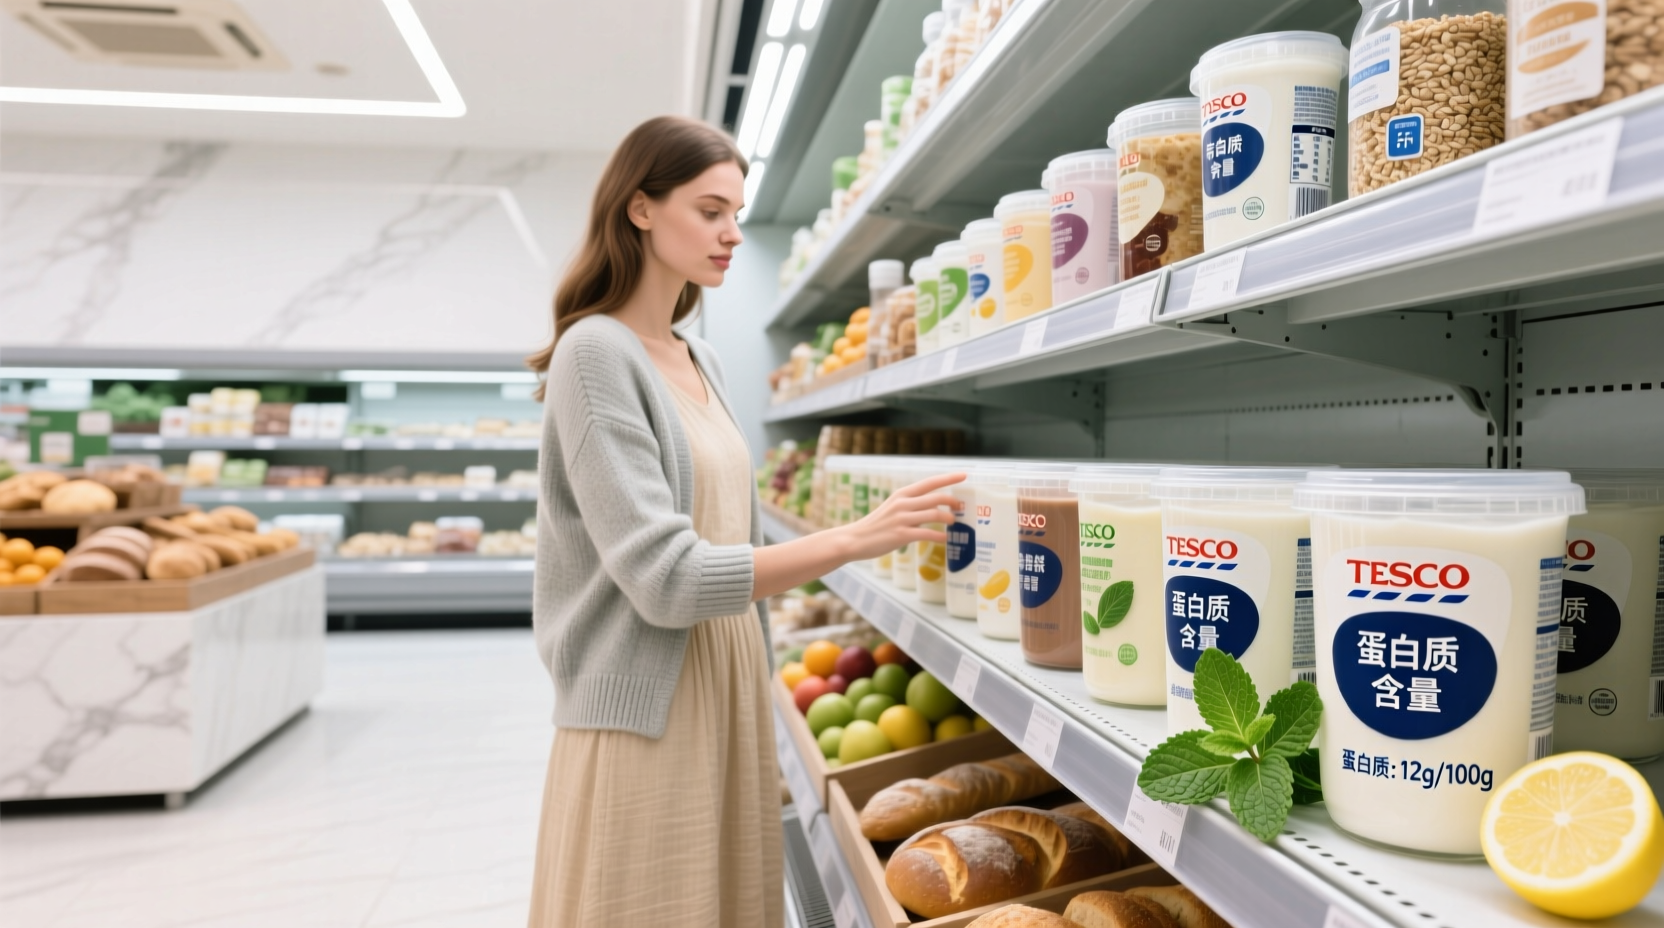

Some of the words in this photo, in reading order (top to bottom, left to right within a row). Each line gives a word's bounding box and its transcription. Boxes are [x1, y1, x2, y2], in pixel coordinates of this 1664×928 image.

[1166, 536, 1238, 560] TESCO
[1346, 559, 1470, 589] TESCO
[1172, 590, 1231, 623] 蛋白质
[1179, 623, 1220, 650] 含量
[1357, 630, 1460, 673] 蛋白质
[1371, 673, 1442, 713] 含量
[1342, 749, 1396, 779] 蛋白质:
[1400, 760, 1493, 792] 12g/100g
